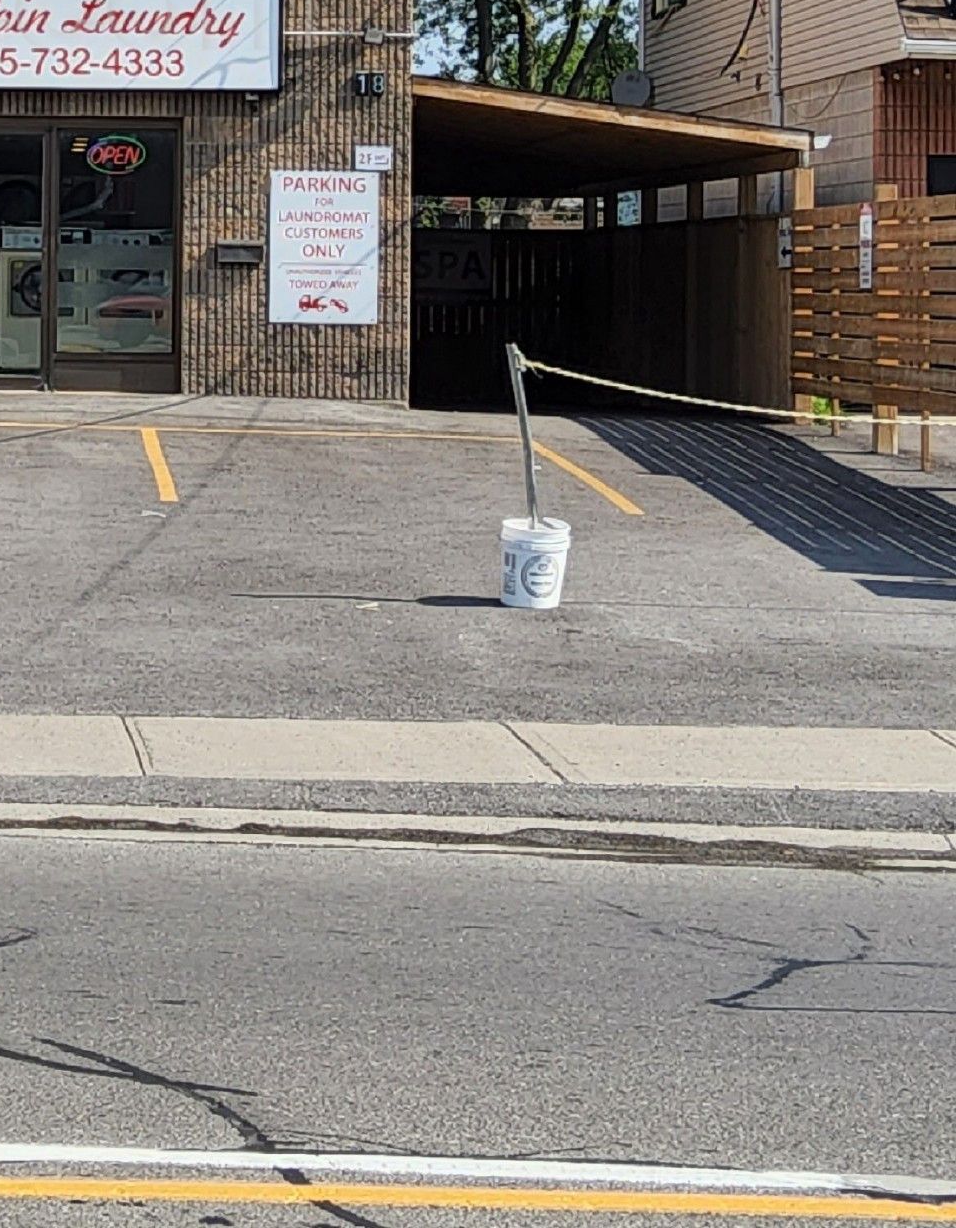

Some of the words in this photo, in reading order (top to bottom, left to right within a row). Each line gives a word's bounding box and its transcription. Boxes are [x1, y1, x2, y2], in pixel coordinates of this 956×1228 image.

[357, 74, 385, 93] 18
[90, 145, 140, 165] OPEN
[282, 176, 367, 194] PARKING
[315, 197, 334, 207] FOR
[278, 210, 371, 224] LAUNDROMAT
[284, 227, 364, 240] CUSTOMERS
[302, 243, 346, 259] ONLY
[289, 279, 327, 289] TOWED
[329, 279, 360, 290] AWAY
